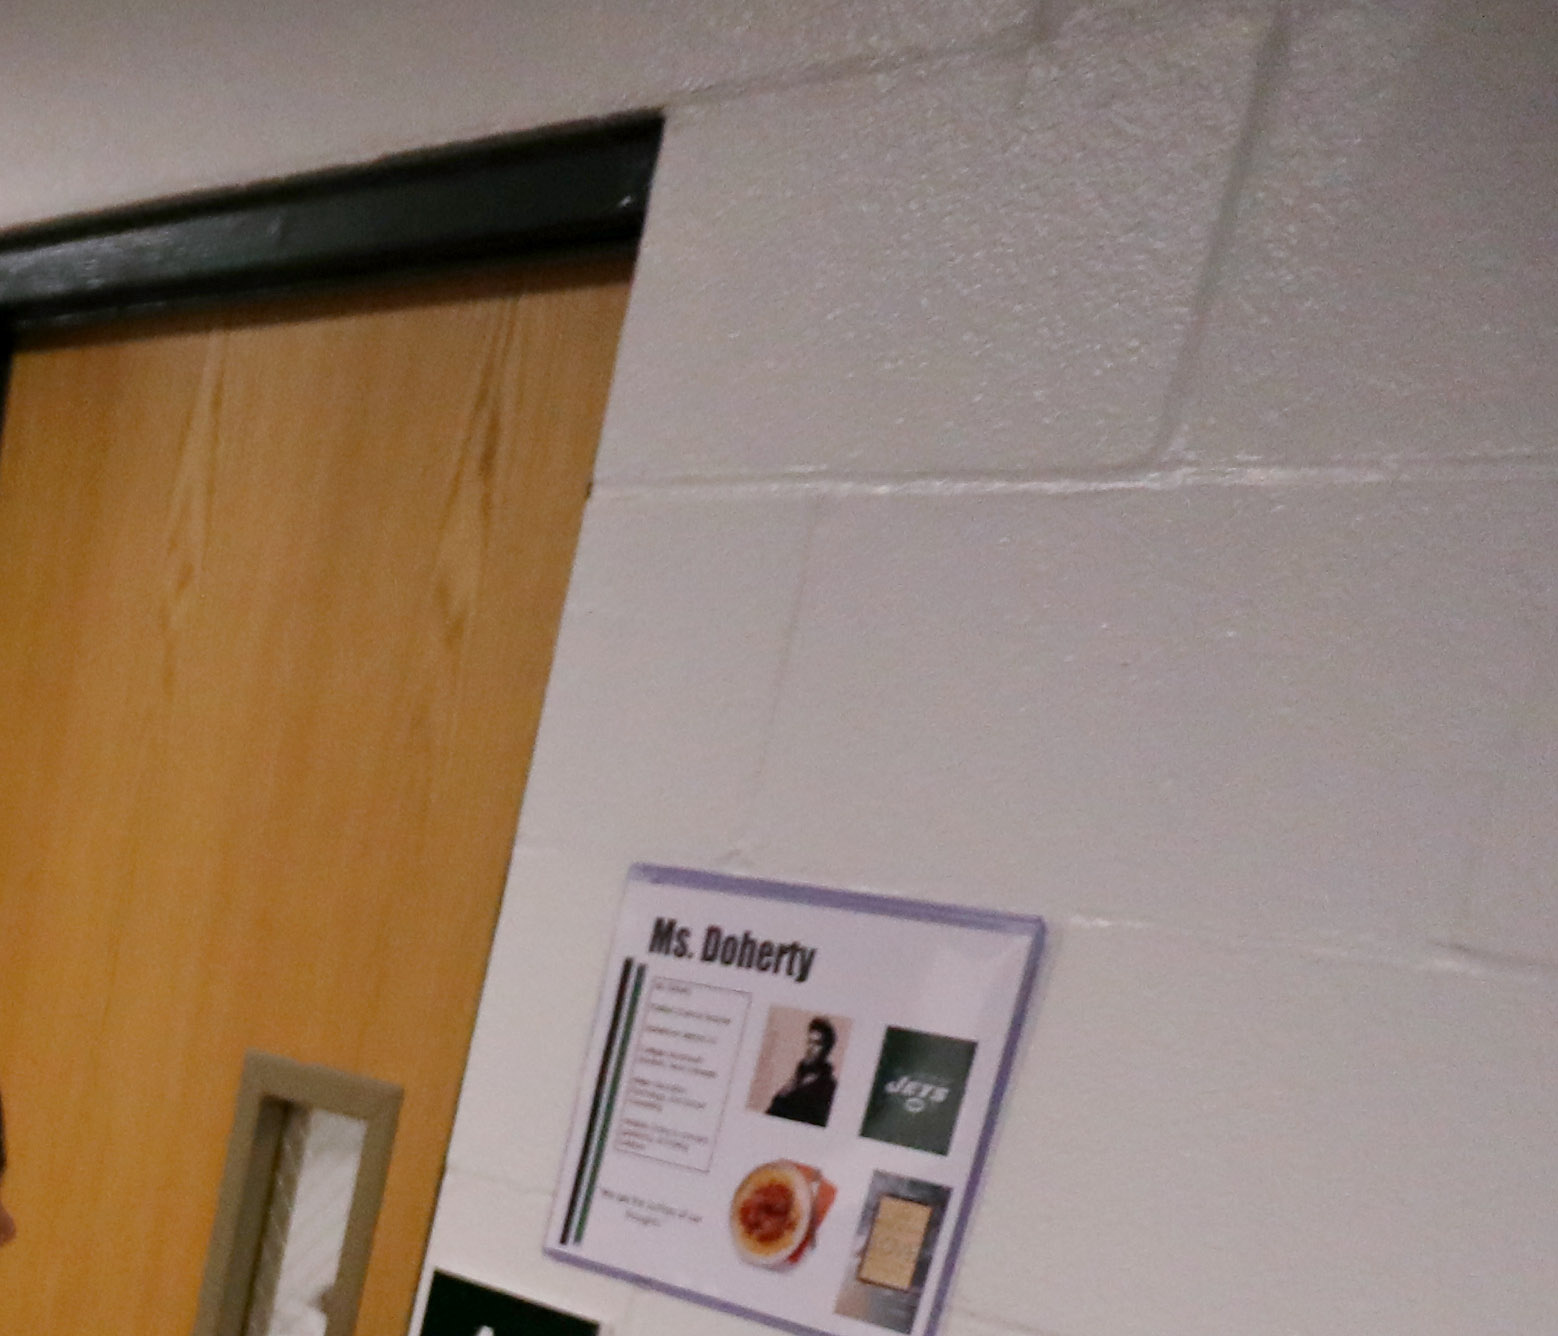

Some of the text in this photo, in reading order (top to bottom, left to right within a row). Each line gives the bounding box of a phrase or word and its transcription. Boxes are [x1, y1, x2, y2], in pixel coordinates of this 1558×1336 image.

[648, 916, 818, 983] Ms. Doherty
[885, 1075, 950, 1103] JETS
